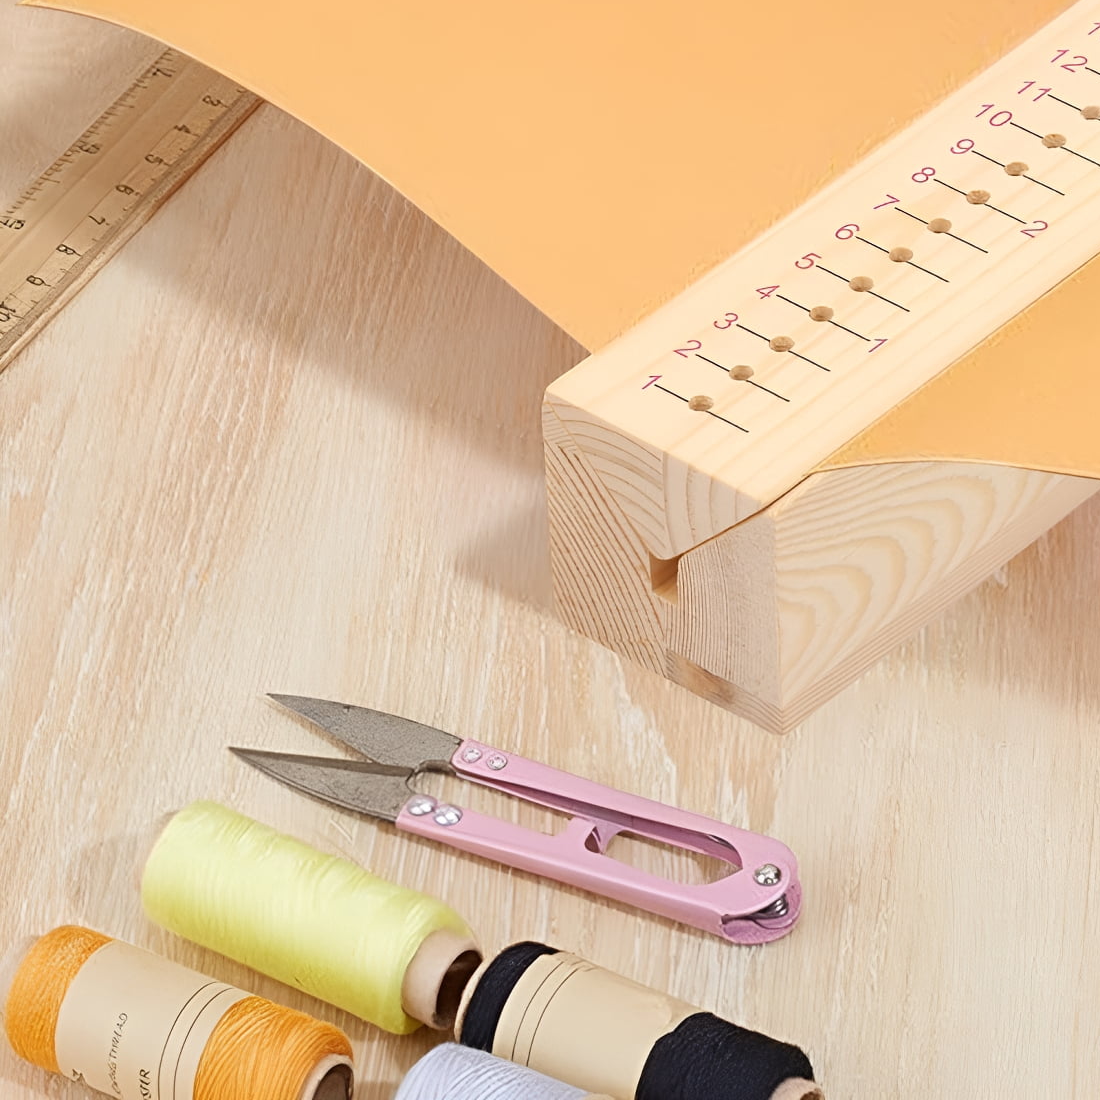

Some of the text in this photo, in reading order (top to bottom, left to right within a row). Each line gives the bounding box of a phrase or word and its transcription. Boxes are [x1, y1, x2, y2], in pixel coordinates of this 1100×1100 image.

[1050, 48, 1088, 73] 12
[1016, 80, 1052, 102] 11
[974, 103, 1013, 127] 10
[950, 138, 975, 155] 9
[911, 166, 936, 184] 8
[873, 194, 900, 210] 7
[834, 223, 860, 241] 6
[1020, 220, 1049, 238] 2
[794, 252, 822, 270] 5
[755, 284, 780, 300] 4
[713, 312, 739, 330] 3
[673, 339, 702, 359] 2
[868, 337, 888, 353] 1
[641, 374, 663, 391] 1
